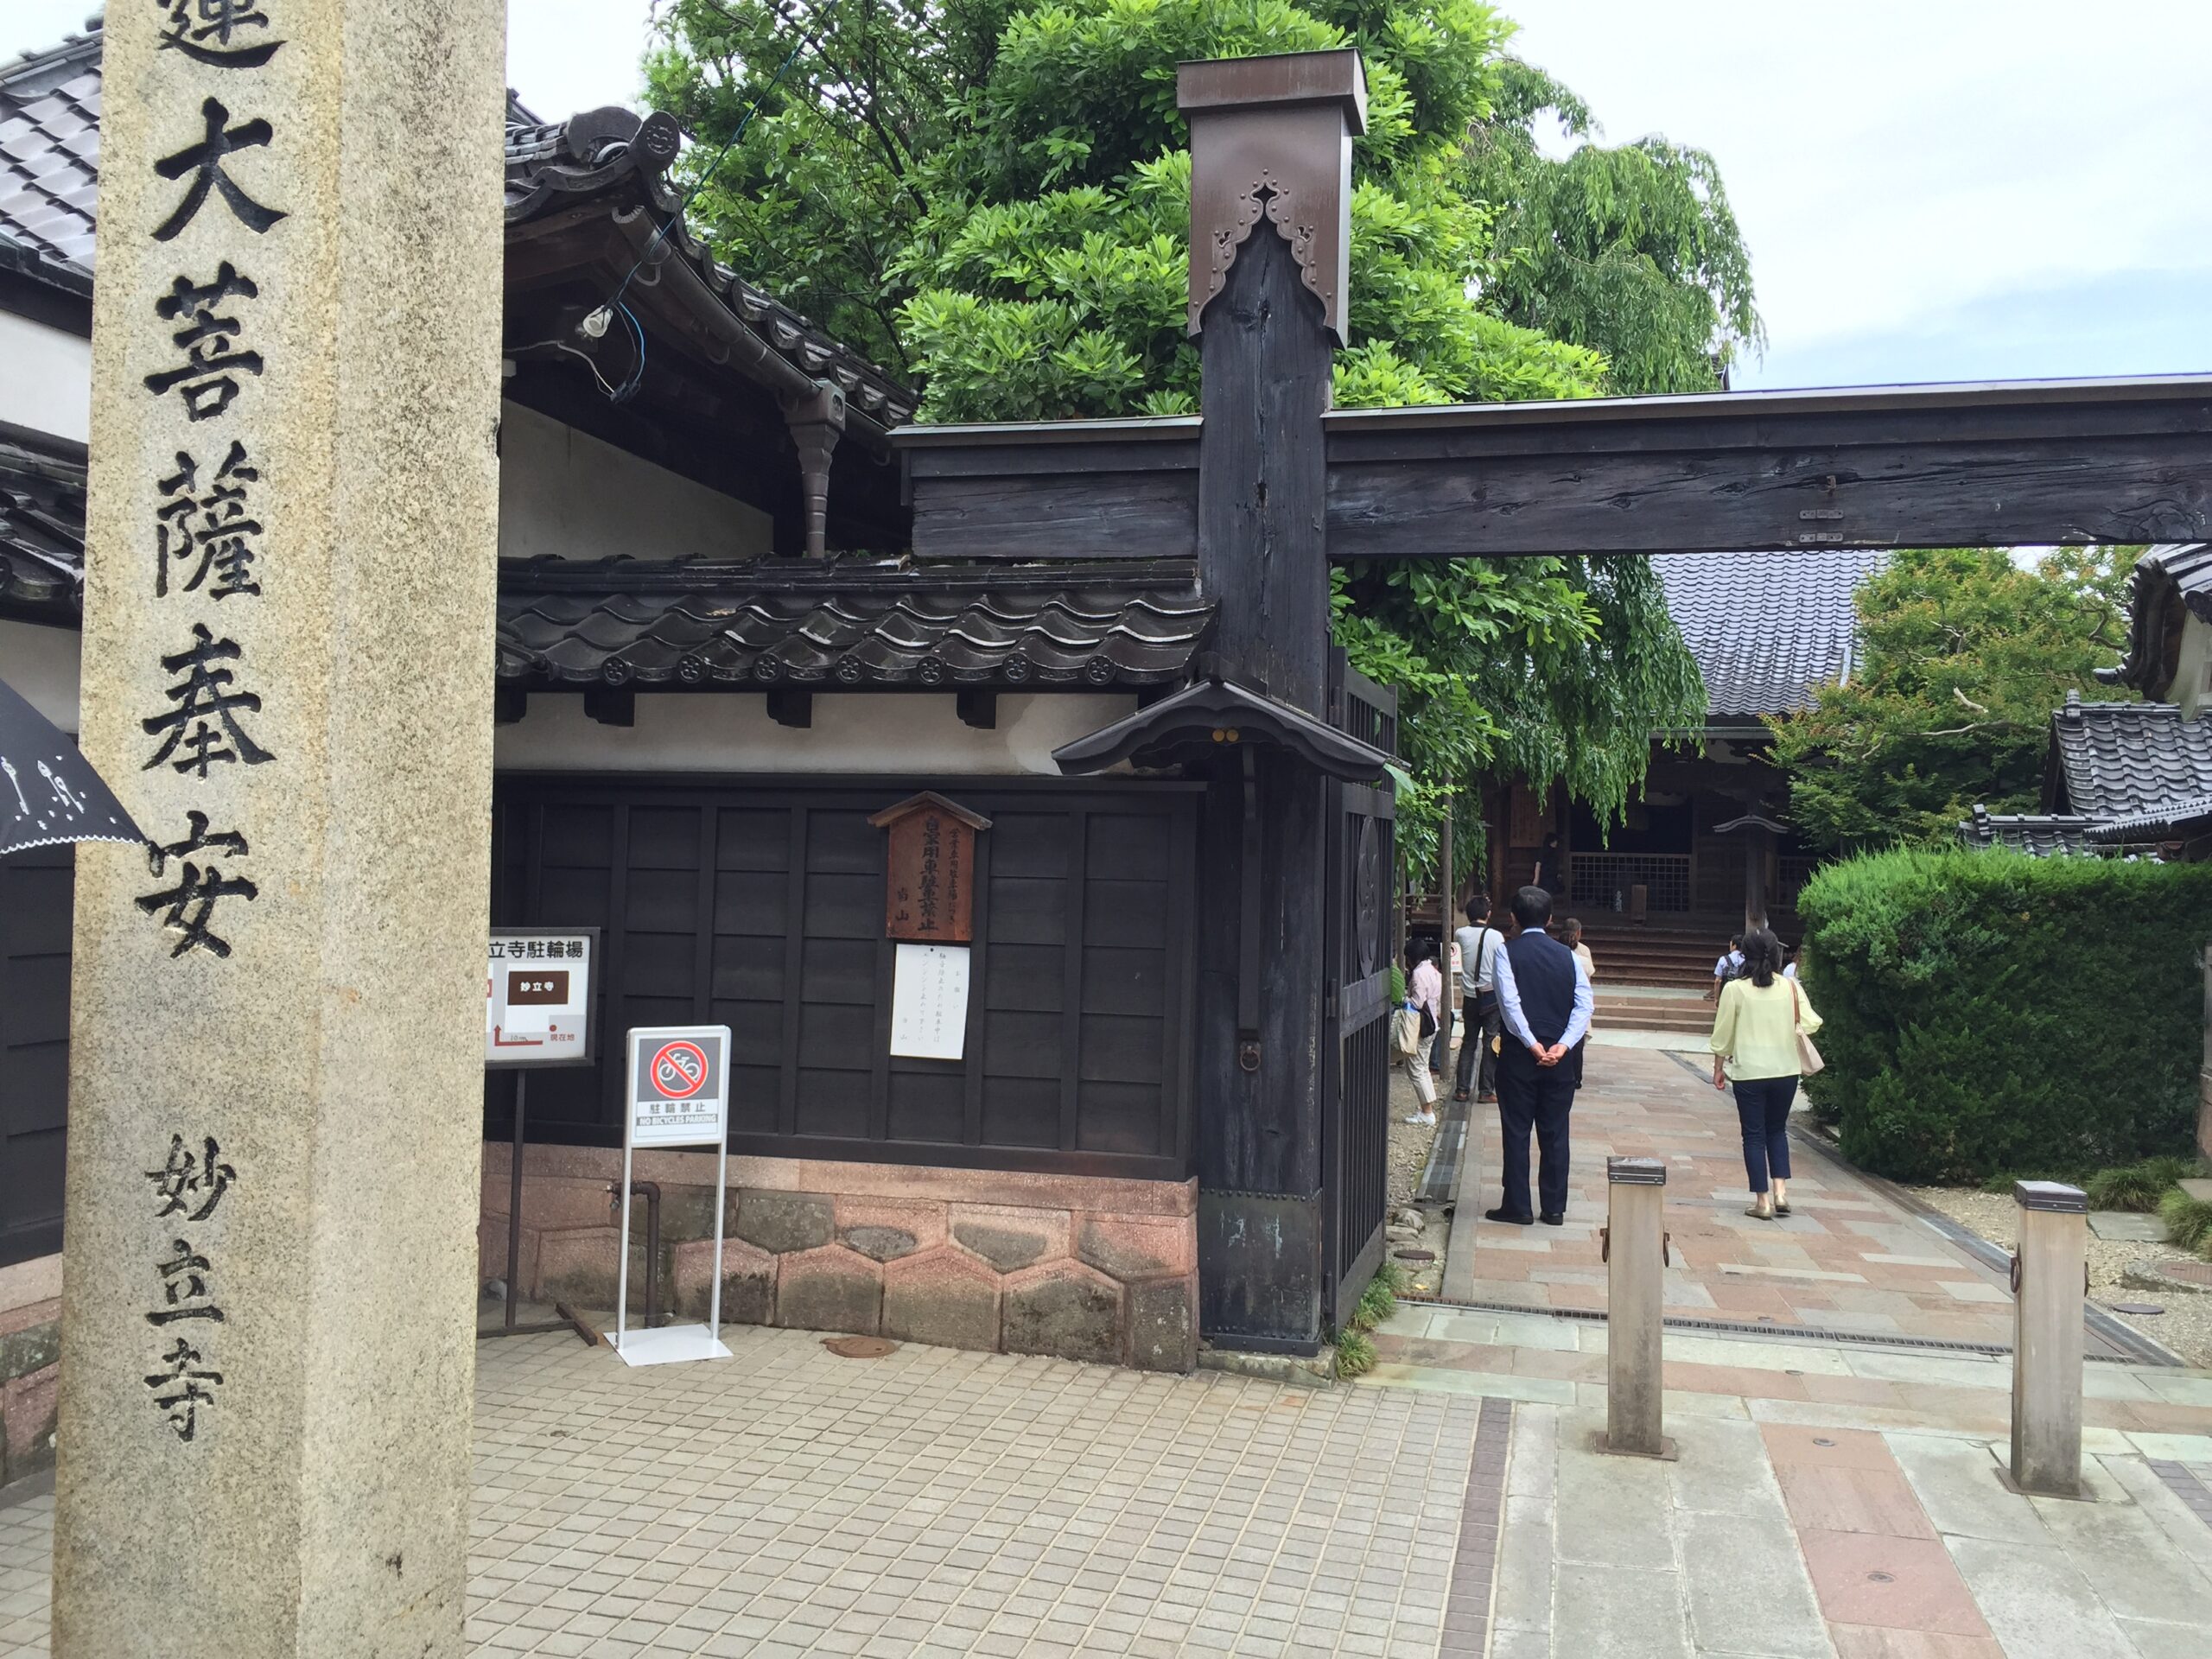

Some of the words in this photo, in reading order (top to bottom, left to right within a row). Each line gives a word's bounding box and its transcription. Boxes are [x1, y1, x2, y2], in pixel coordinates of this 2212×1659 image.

[918, 816, 940, 931] 自家用車駐車禁止
[488, 940, 583, 958] 立寺駐輪場
[520, 982, 554, 992] 妙立寺
[650, 1103, 705, 1114] 駐輪禁止
[639, 1117, 651, 1126] NO
[685, 1115, 716, 1123] PARKING
[143, 1134, 236, 1442] 妙立寺
